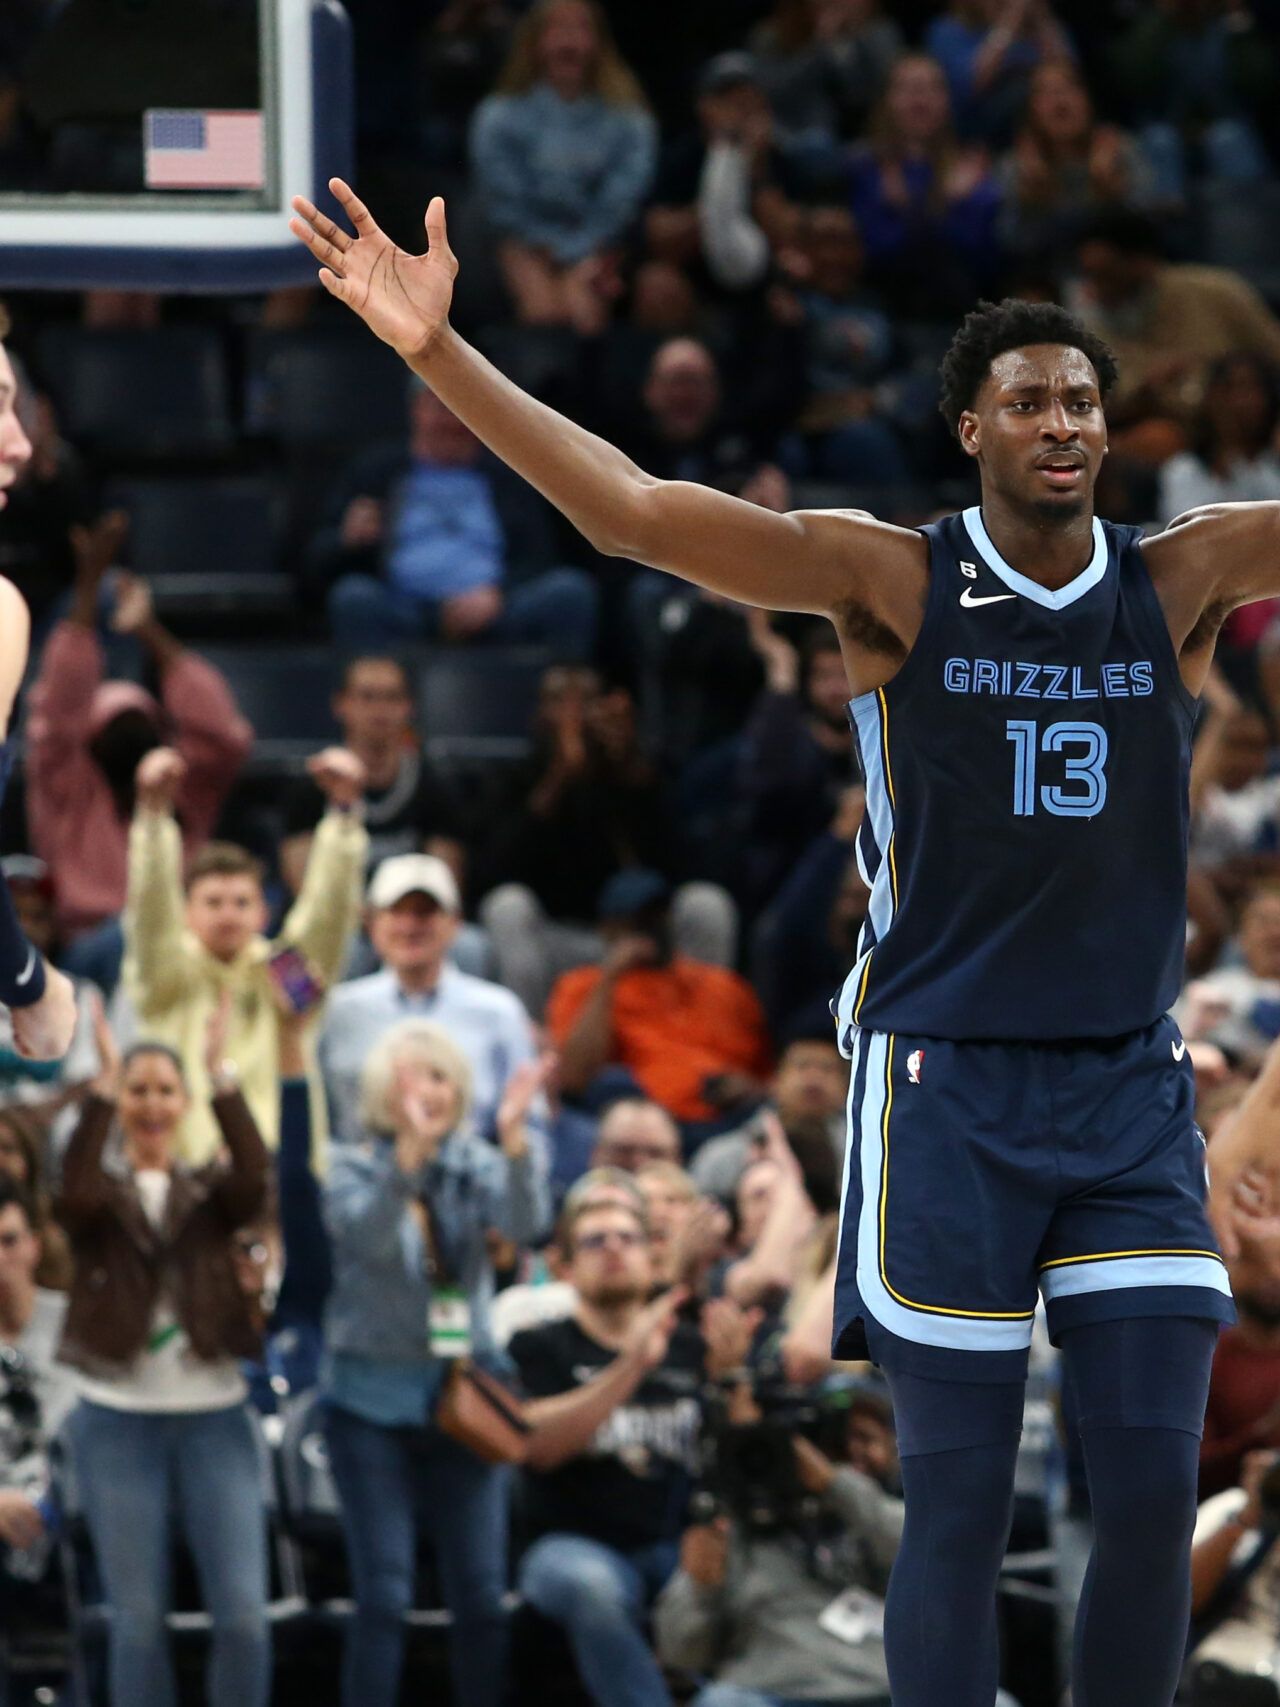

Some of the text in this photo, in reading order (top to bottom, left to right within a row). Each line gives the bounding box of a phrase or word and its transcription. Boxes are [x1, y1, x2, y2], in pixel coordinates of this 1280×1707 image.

[960, 560, 977, 579] 6
[944, 657, 1154, 700] GRIZZLES
[1006, 719, 1108, 817] 13
